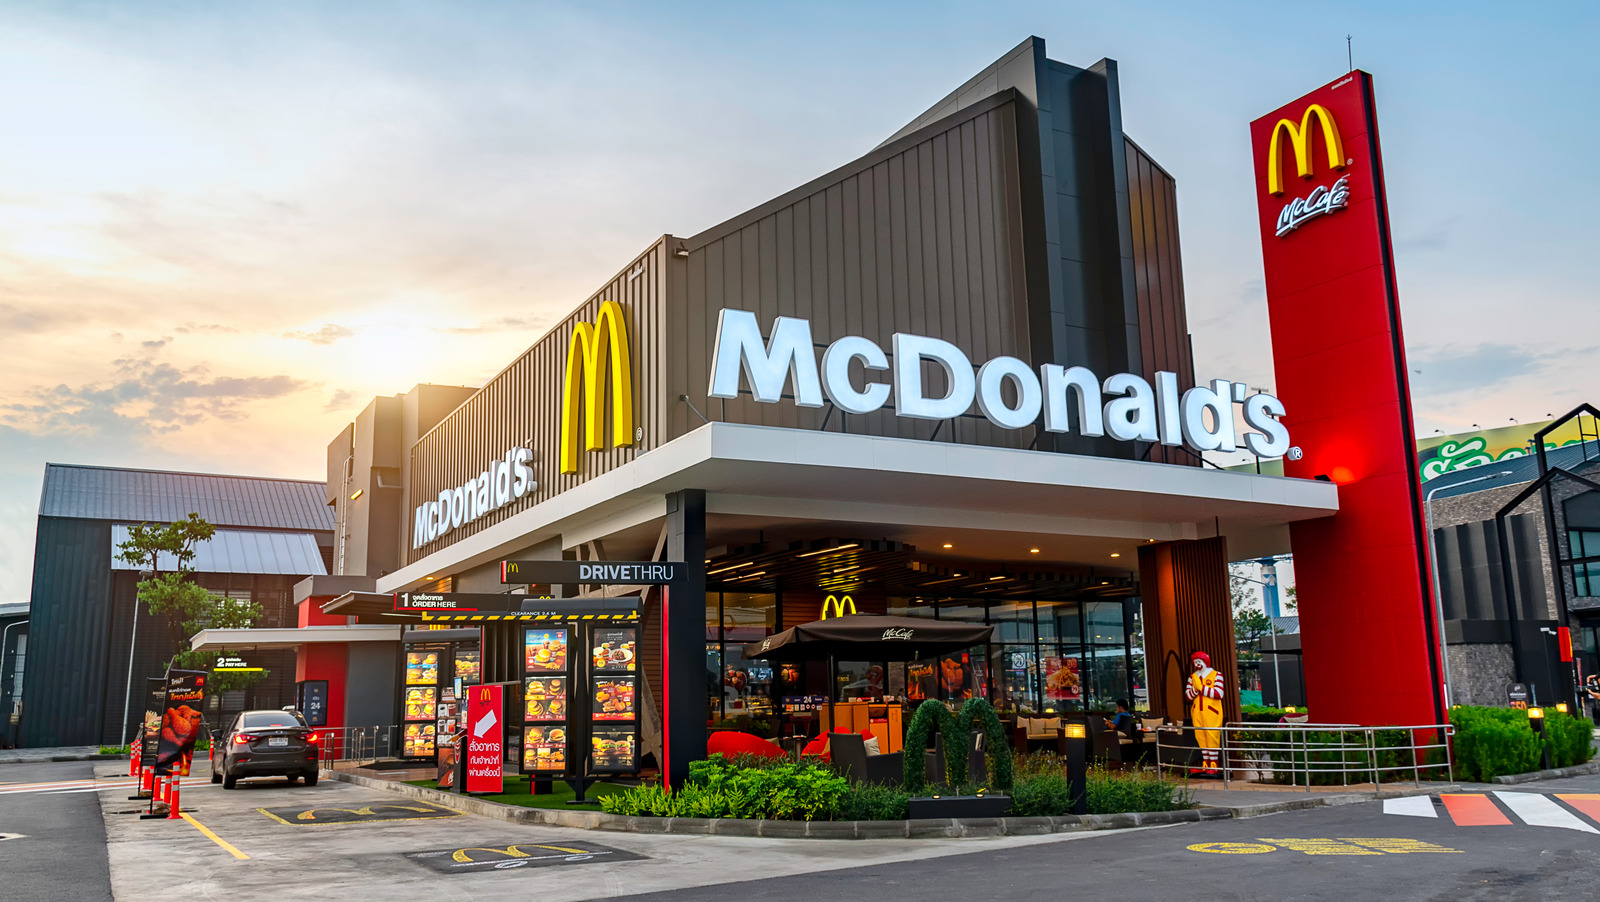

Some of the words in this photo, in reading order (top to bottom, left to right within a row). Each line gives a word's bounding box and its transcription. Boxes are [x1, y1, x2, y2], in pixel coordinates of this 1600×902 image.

[1275, 174, 1350, 237] McCafé
[708, 308, 1290, 459] McDonald's
[413, 446, 533, 549] McDonald's
[401, 592, 408, 607] 1
[216, 657, 225, 667] 2
[469, 738, 500, 752] สั่งอาหาร
